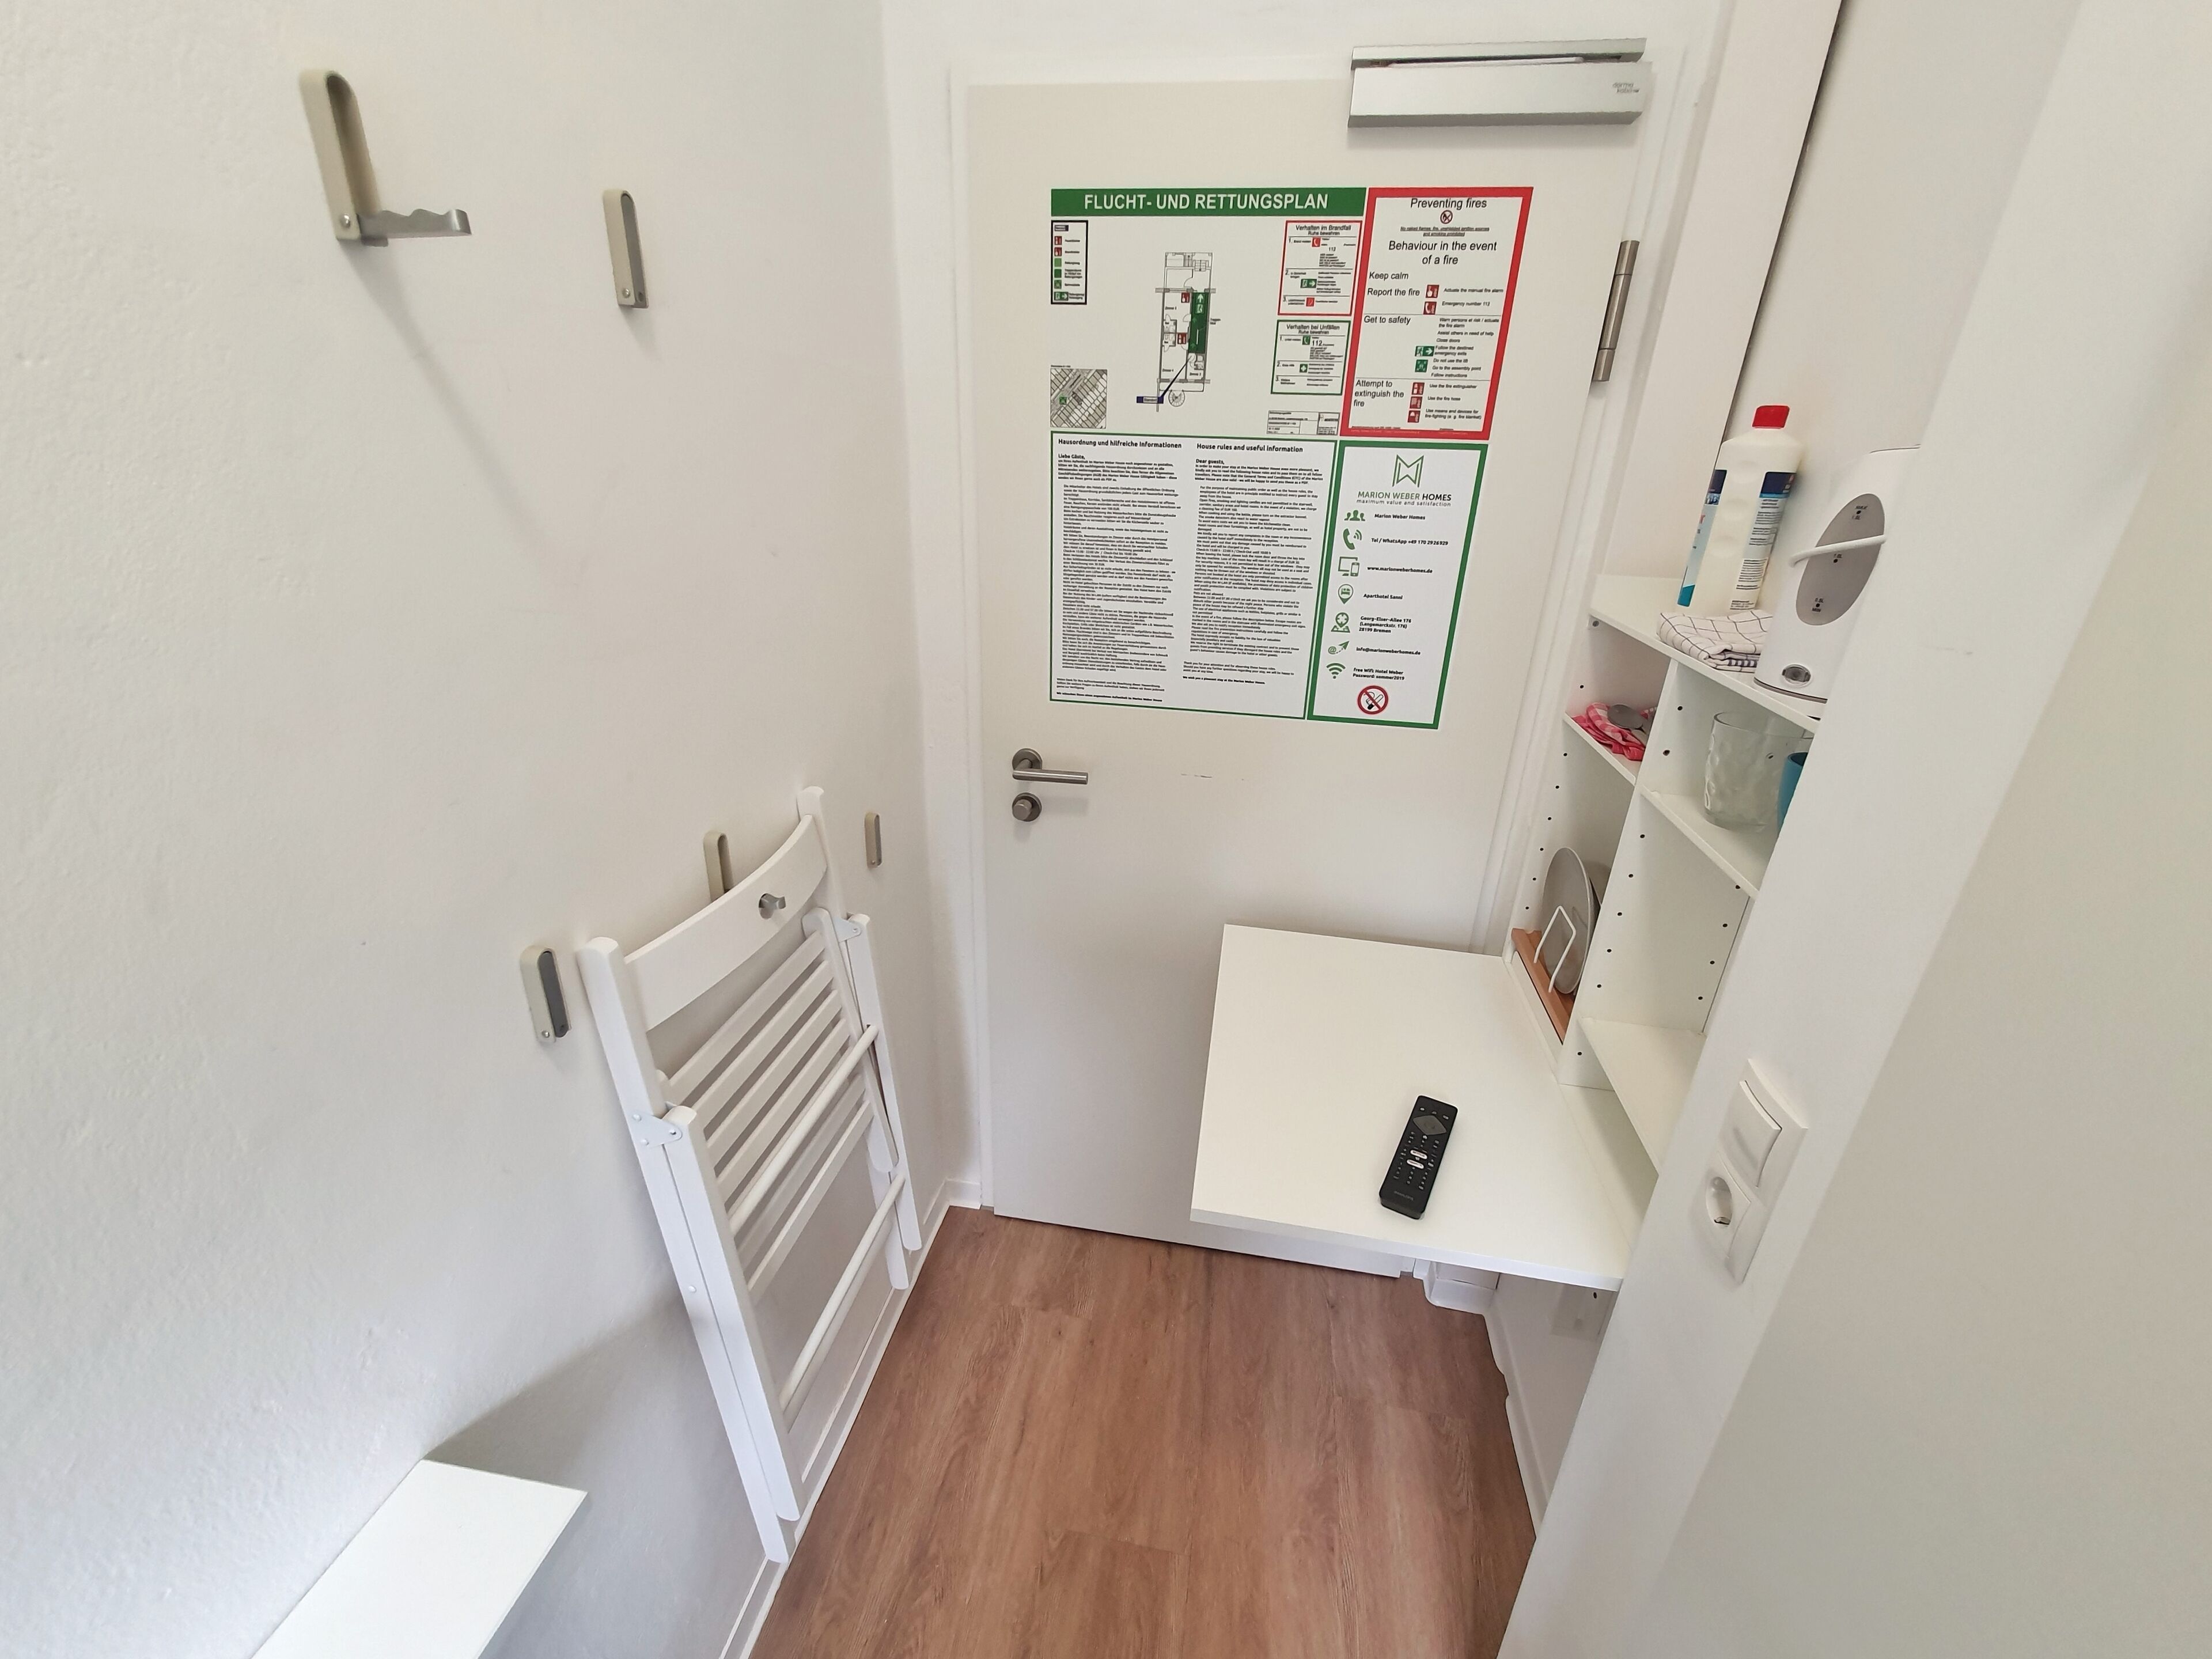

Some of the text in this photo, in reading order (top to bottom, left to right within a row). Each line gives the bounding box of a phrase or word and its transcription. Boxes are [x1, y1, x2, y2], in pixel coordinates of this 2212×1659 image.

[1084, 194, 1328, 210] FLUCHT- UND RETTUNGSPLAN
[1411, 198, 1487, 210] Preventing fires
[1389, 241, 1497, 251] Behaviour in the event
[1422, 255, 1433, 264] of
[1443, 255, 1458, 264] fire
[1369, 272, 1388, 281] Keep
[1368, 288, 1392, 297] Report
[1389, 316, 1411, 325] safety
[1356, 380, 1384, 389] Attempt
[1355, 391, 1391, 399] extinguish
